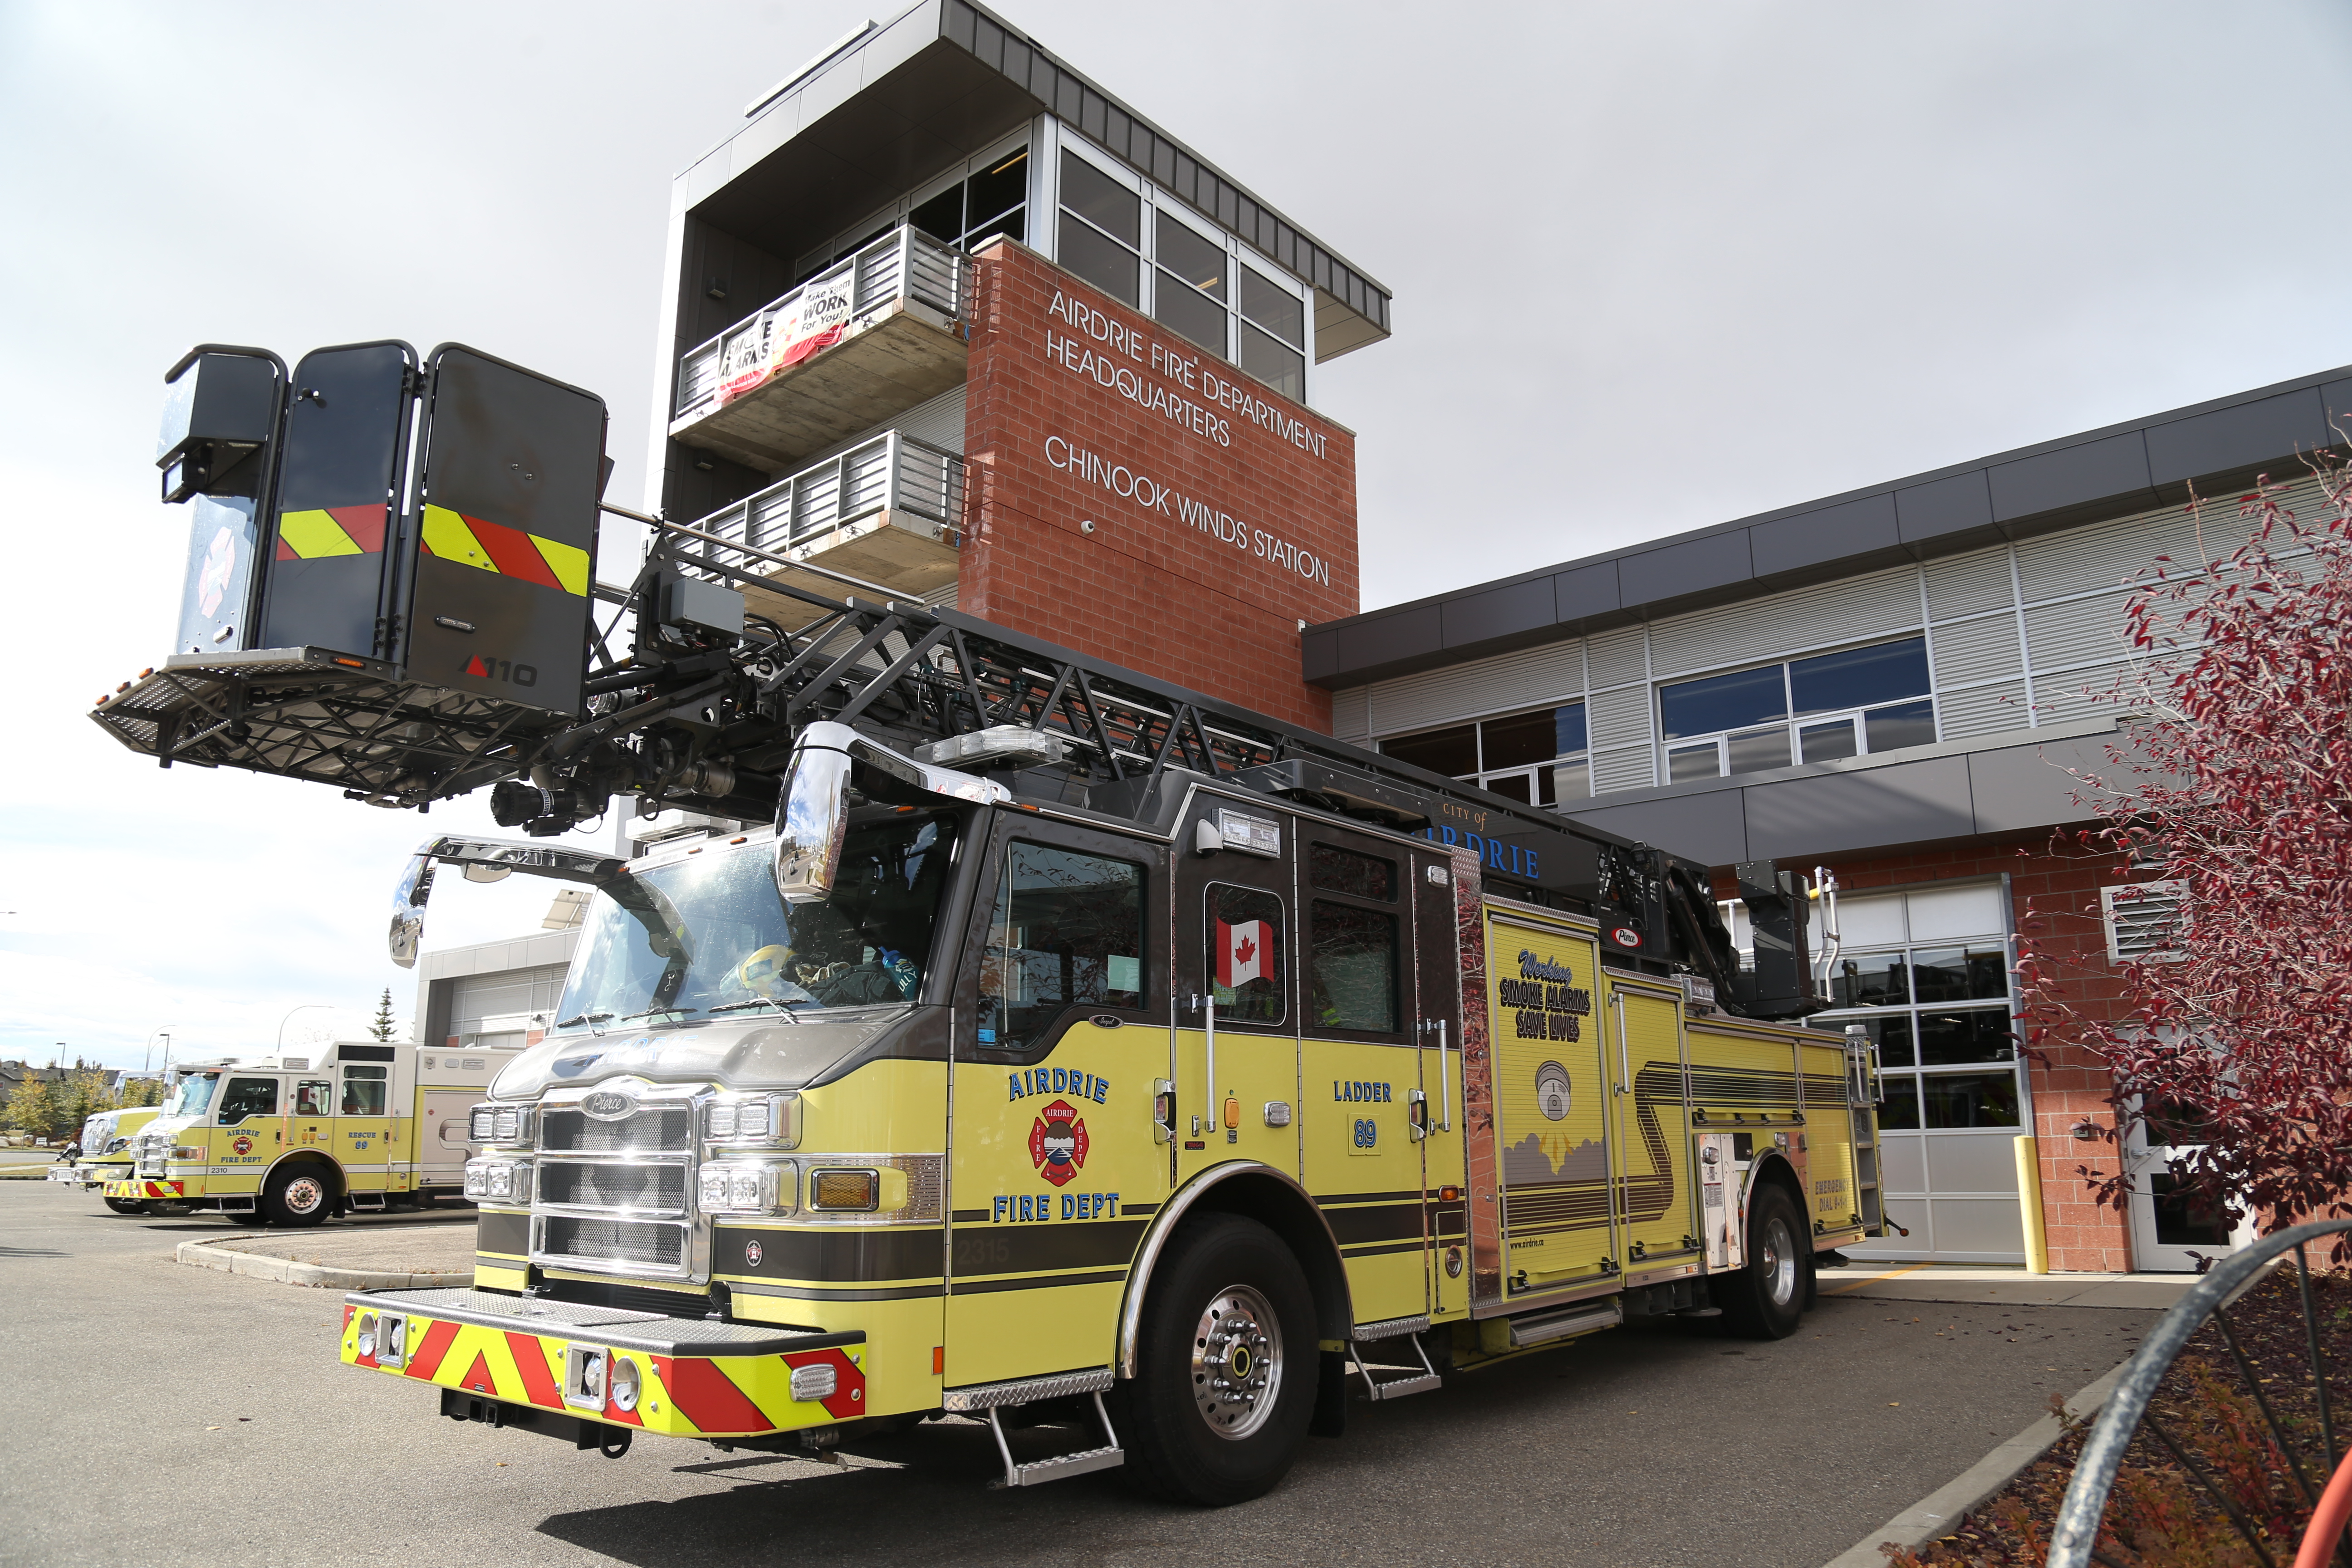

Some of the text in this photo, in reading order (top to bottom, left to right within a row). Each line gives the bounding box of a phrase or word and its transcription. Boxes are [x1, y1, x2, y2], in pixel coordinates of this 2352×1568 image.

[804, 291, 848, 321] WORK
[801, 309, 844, 333] For You!
[1047, 329, 1230, 447] HEADQUARTERS
[1049, 290, 1327, 460] AIRDRIE FIRE DEPARTMENT
[1045, 435, 1329, 587] CHINOOK WINDS STATION
[1443, 803, 1469, 820] CITY
[1410, 824, 1539, 879] RDRIE
[1618, 929, 1636, 943] Pierce
[1518, 949, 1573, 987] Working
[1499, 977, 1590, 1016] SMOKE ALARMS
[1098, 1017, 1115, 1027] Impel
[1516, 1009, 1580, 1043] SAVE LIVES
[583, 1035, 699, 1067] AIRDRIE
[1009, 1067, 1110, 1105] AIRDRIE
[1334, 1080, 1392, 1102] LADDER
[593, 1094, 623, 1114] Pierce
[1045, 1108, 1074, 1119] AIRDRIE
[355, 1141, 368, 1150] 89
[1354, 1119, 1377, 1149] 89
[1815, 1178, 1850, 1195] EMERGENCY
[993, 1192, 1120, 1224] FIRE DEPT
[1819, 1197, 1833, 1212] DIAL
[957, 1238, 1009, 1265] 2315
[1510, 1238, 1544, 1250] www.airdrie.ca
